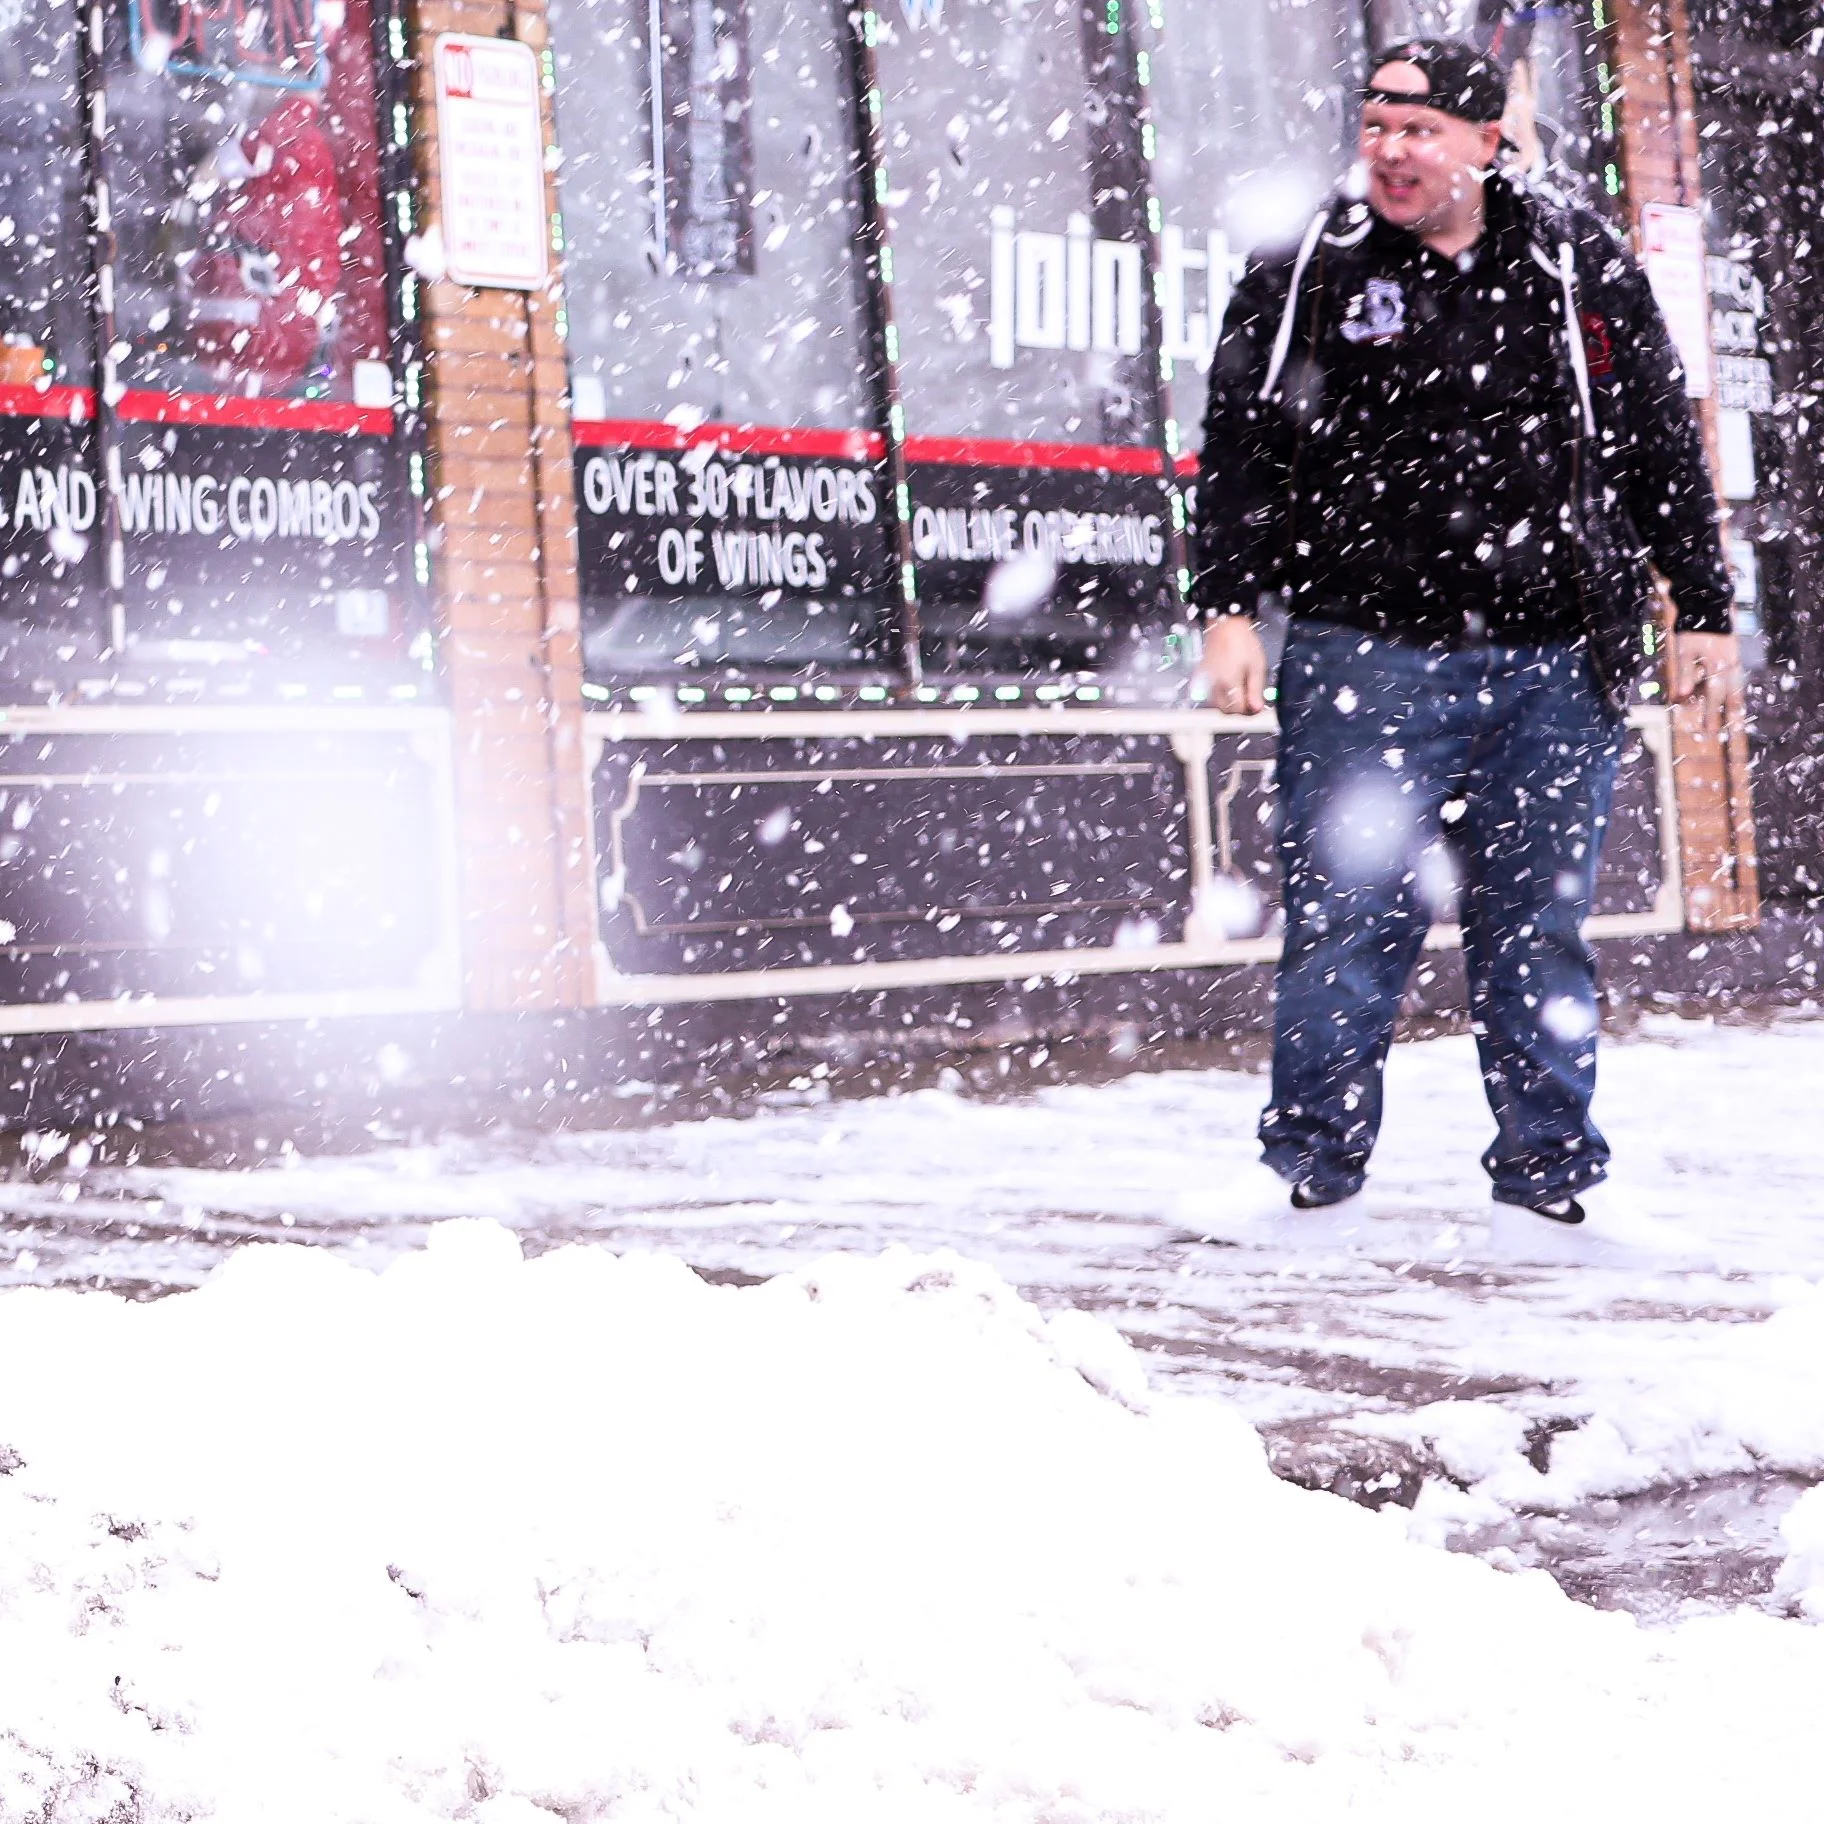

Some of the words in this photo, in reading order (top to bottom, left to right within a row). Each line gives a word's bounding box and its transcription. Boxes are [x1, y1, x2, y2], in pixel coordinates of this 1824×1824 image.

[989, 203, 1142, 369] join
[15, 464, 97, 532] AND
[117, 472, 221, 536] WING
[228, 475, 381, 539] COMBOS
[583, 456, 680, 516] OVER
[688, 460, 729, 518] 30
[735, 462, 877, 524] FLAVORS
[657, 527, 705, 586] OF
[712, 531, 828, 588] WINGS
